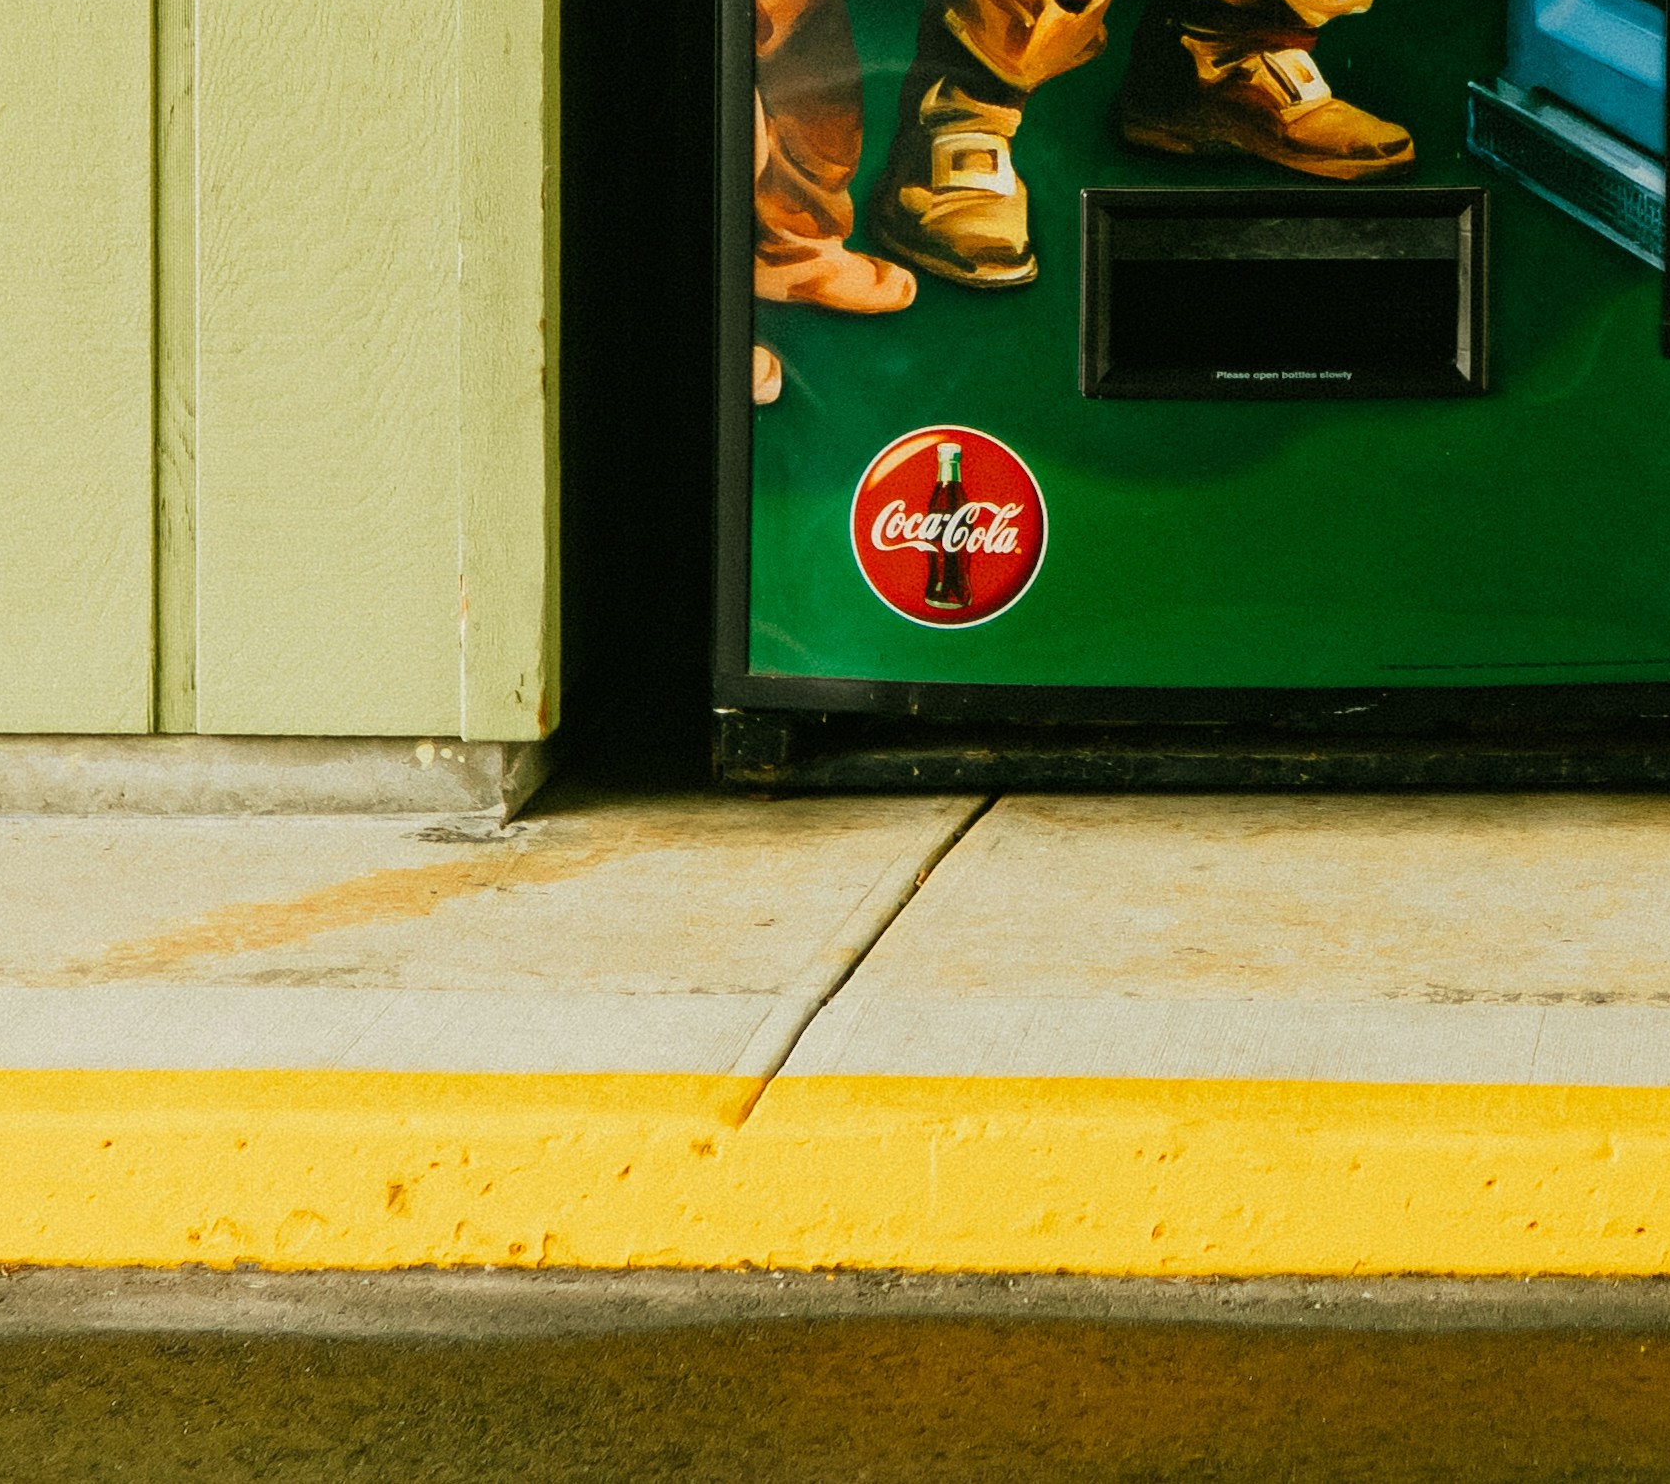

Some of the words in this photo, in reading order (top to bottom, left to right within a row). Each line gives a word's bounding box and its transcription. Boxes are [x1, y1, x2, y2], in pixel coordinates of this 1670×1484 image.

[1216, 371, 1250, 379] Please
[1253, 372, 1279, 381] open
[1281, 371, 1317, 379] bottles
[1319, 371, 1352, 380] slowly
[871, 500, 1024, 554] Coca-Cola
